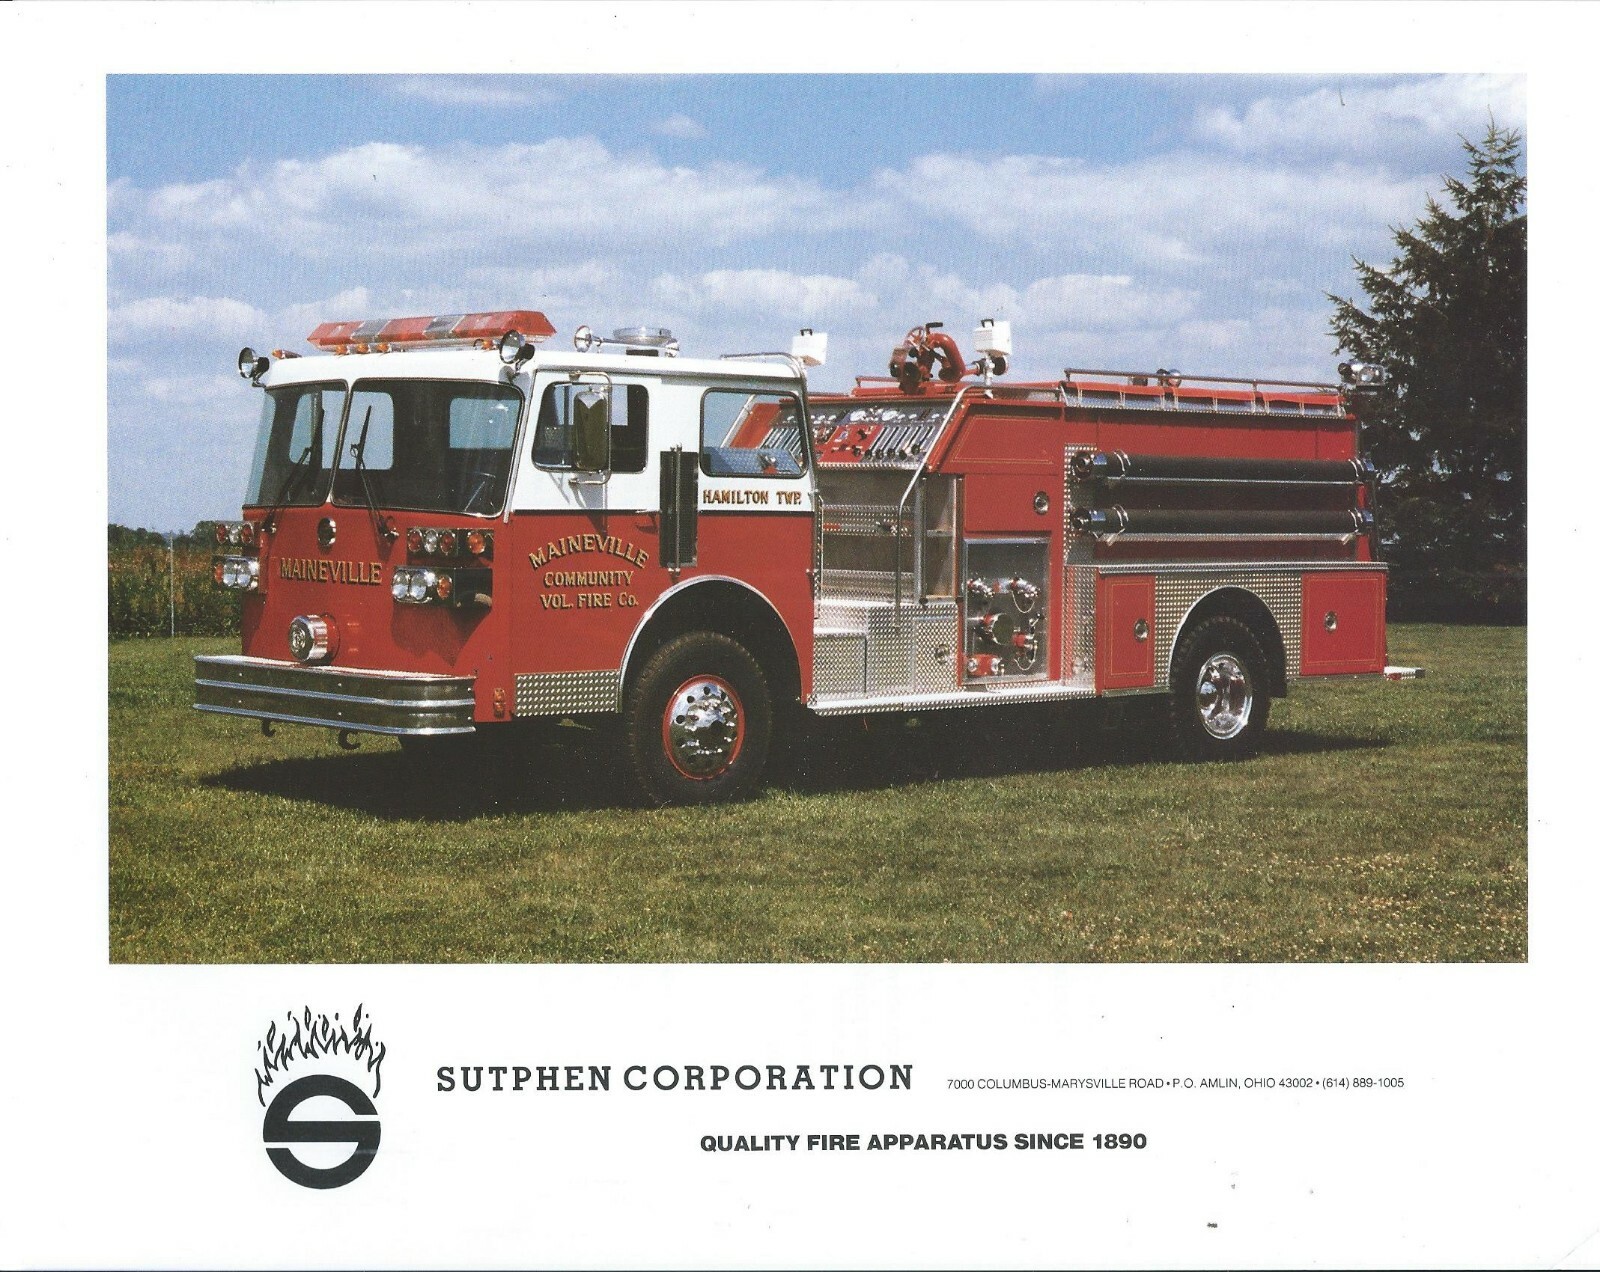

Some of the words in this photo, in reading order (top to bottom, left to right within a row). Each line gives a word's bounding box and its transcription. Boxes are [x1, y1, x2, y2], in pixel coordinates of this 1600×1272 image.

[702, 489, 769, 505] HAMILTON
[775, 490, 802, 506] TWP.
[528, 533, 650, 570] MAINEVILLE
[279, 557, 383, 585] MAINEVILLE
[544, 570, 635, 588] COMMUNITY
[540, 593, 574, 609] VOL.
[577, 593, 612, 608] FIRE
[437, 1066, 611, 1091] SUTPHEN
[624, 1065, 913, 1091] CORPORATION
[947, 1079, 975, 1090] 7000
[977, 1078, 1126, 1090] COLUMBUS-MARYSVILLE
[1128, 1078, 1165, 1089] ROAD
[1172, 1078, 1198, 1089] P.O.
[1199, 1077, 1242, 1090] AMLIN,
[1243, 1077, 1276, 1089] OHIO
[1278, 1077, 1314, 1089] 43002
[1322, 1077, 1350, 1091] (614)
[1352, 1077, 1405, 1088] 889-1005
[701, 1134, 800, 1152] QUALITY
[807, 1134, 861, 1151] FIRE
[866, 1133, 1008, 1151] APPARATUS
[1014, 1133, 1084, 1150] SINCE
[1092, 1133, 1147, 1150] 1890
